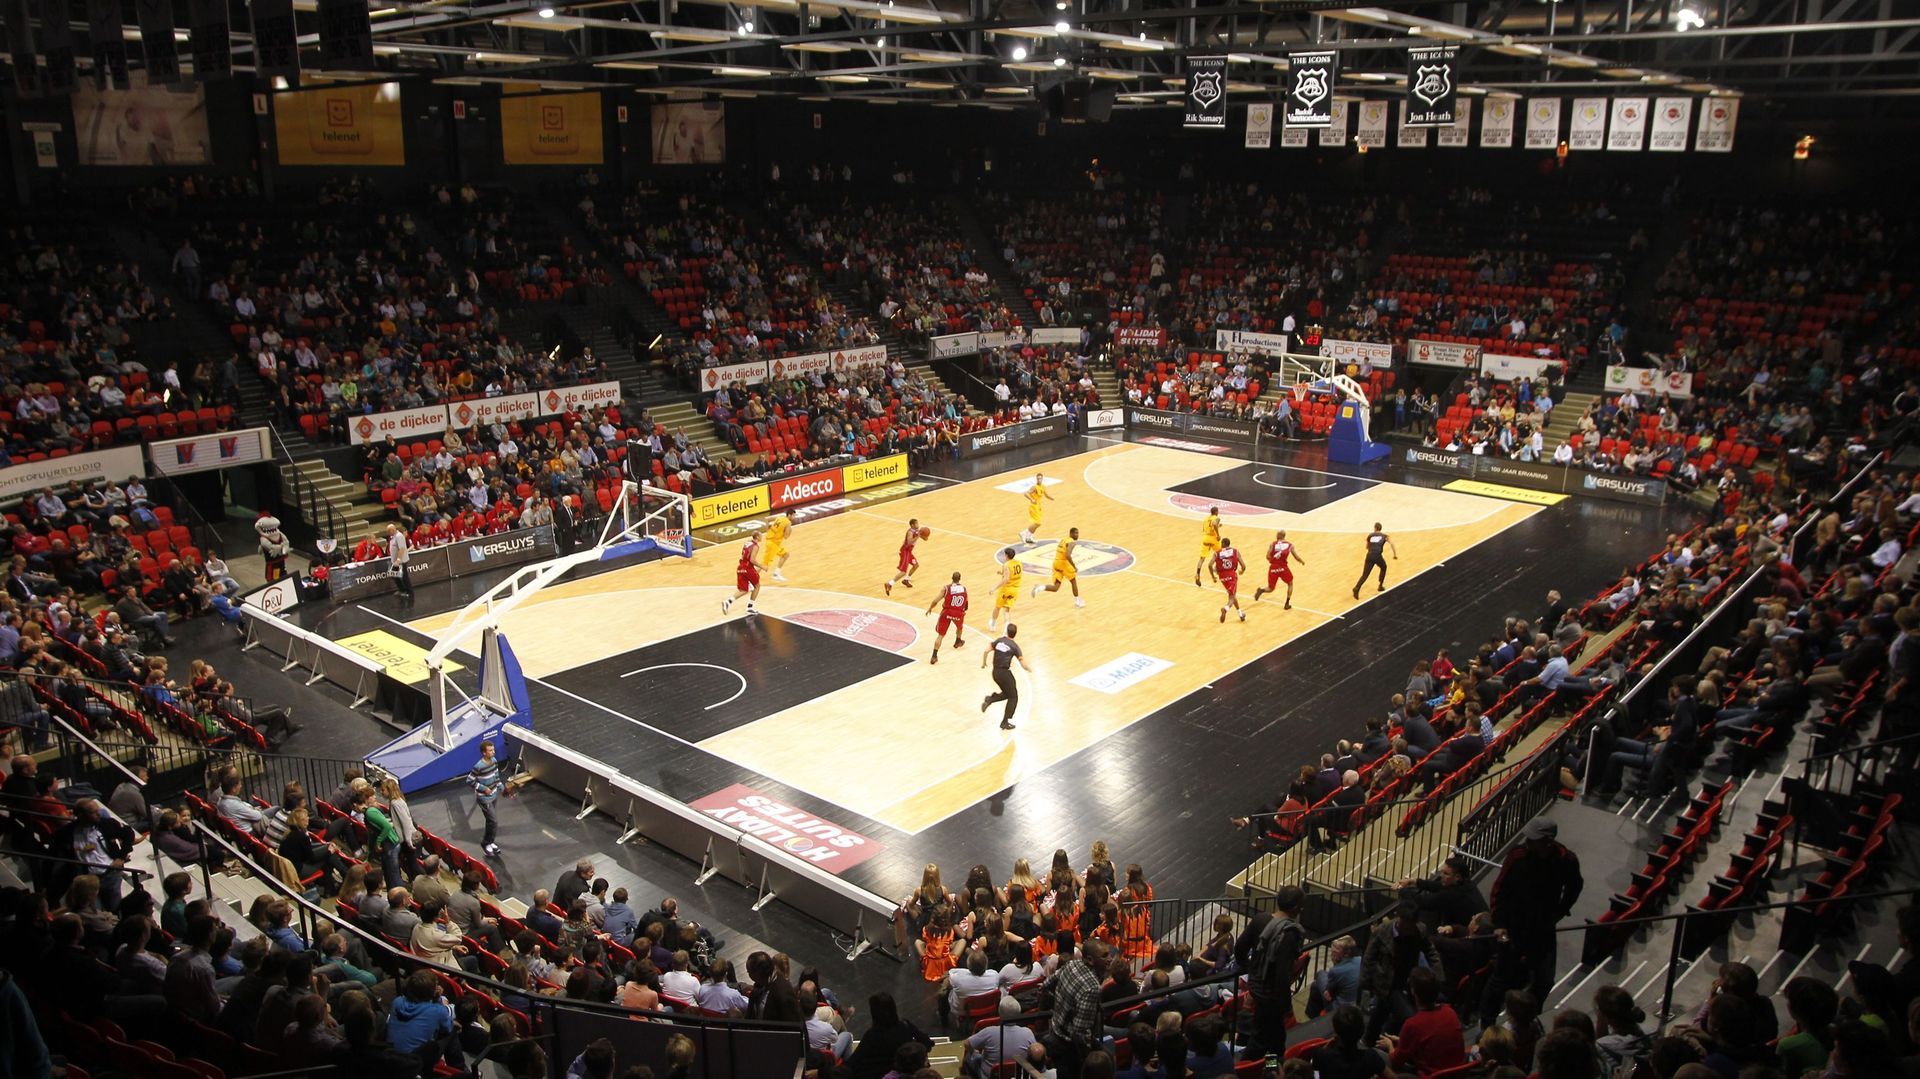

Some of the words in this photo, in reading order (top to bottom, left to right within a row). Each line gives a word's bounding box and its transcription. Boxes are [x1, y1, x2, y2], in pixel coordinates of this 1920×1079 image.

[1292, 57, 1305, 65] THE
[1306, 55, 1331, 64] ICONS
[1411, 52, 1429, 60] THE
[455, 103, 464, 115] M
[1185, 113, 1197, 122] Rik
[1409, 112, 1424, 122] Jon
[322, 131, 361, 143] telenet
[538, 134, 569, 144] telenet
[1306, 335, 1320, 346] 23
[848, 353, 858, 364] de
[860, 350, 885, 363] dijcker
[787, 361, 797, 372] de
[800, 358, 828, 371] dijcker
[721, 370, 733, 381] de
[736, 366, 765, 381] dijcker
[565, 391, 578, 403] de
[582, 388, 617, 402] dijcker
[477, 404, 491, 416] de
[496, 400, 535, 415] dijcker
[379, 418, 395, 431] de
[401, 414, 444, 429] dijcker
[1134, 411, 1173, 425] VERSLUYS
[973, 433, 1007, 445] VERSLUYS
[1409, 448, 1459, 466] VERSLUYS
[864, 464, 899, 480] telenet
[1501, 467, 1517, 475] JAAR
[1517, 469, 1548, 480] ERVARING
[781, 478, 833, 502] Adecco
[1587, 474, 1645, 493] VERSLUYS
[716, 495, 759, 516] telenet
[472, 536, 535, 558] VERSLUYS
[1013, 564, 1022, 575] 10
[265, 593, 282, 611] P&V
[951, 595, 964, 607] 10
[347, 640, 410, 668] telenet
[737, 795, 864, 848] SUITES
[702, 806, 841, 862] HOLIDAY
